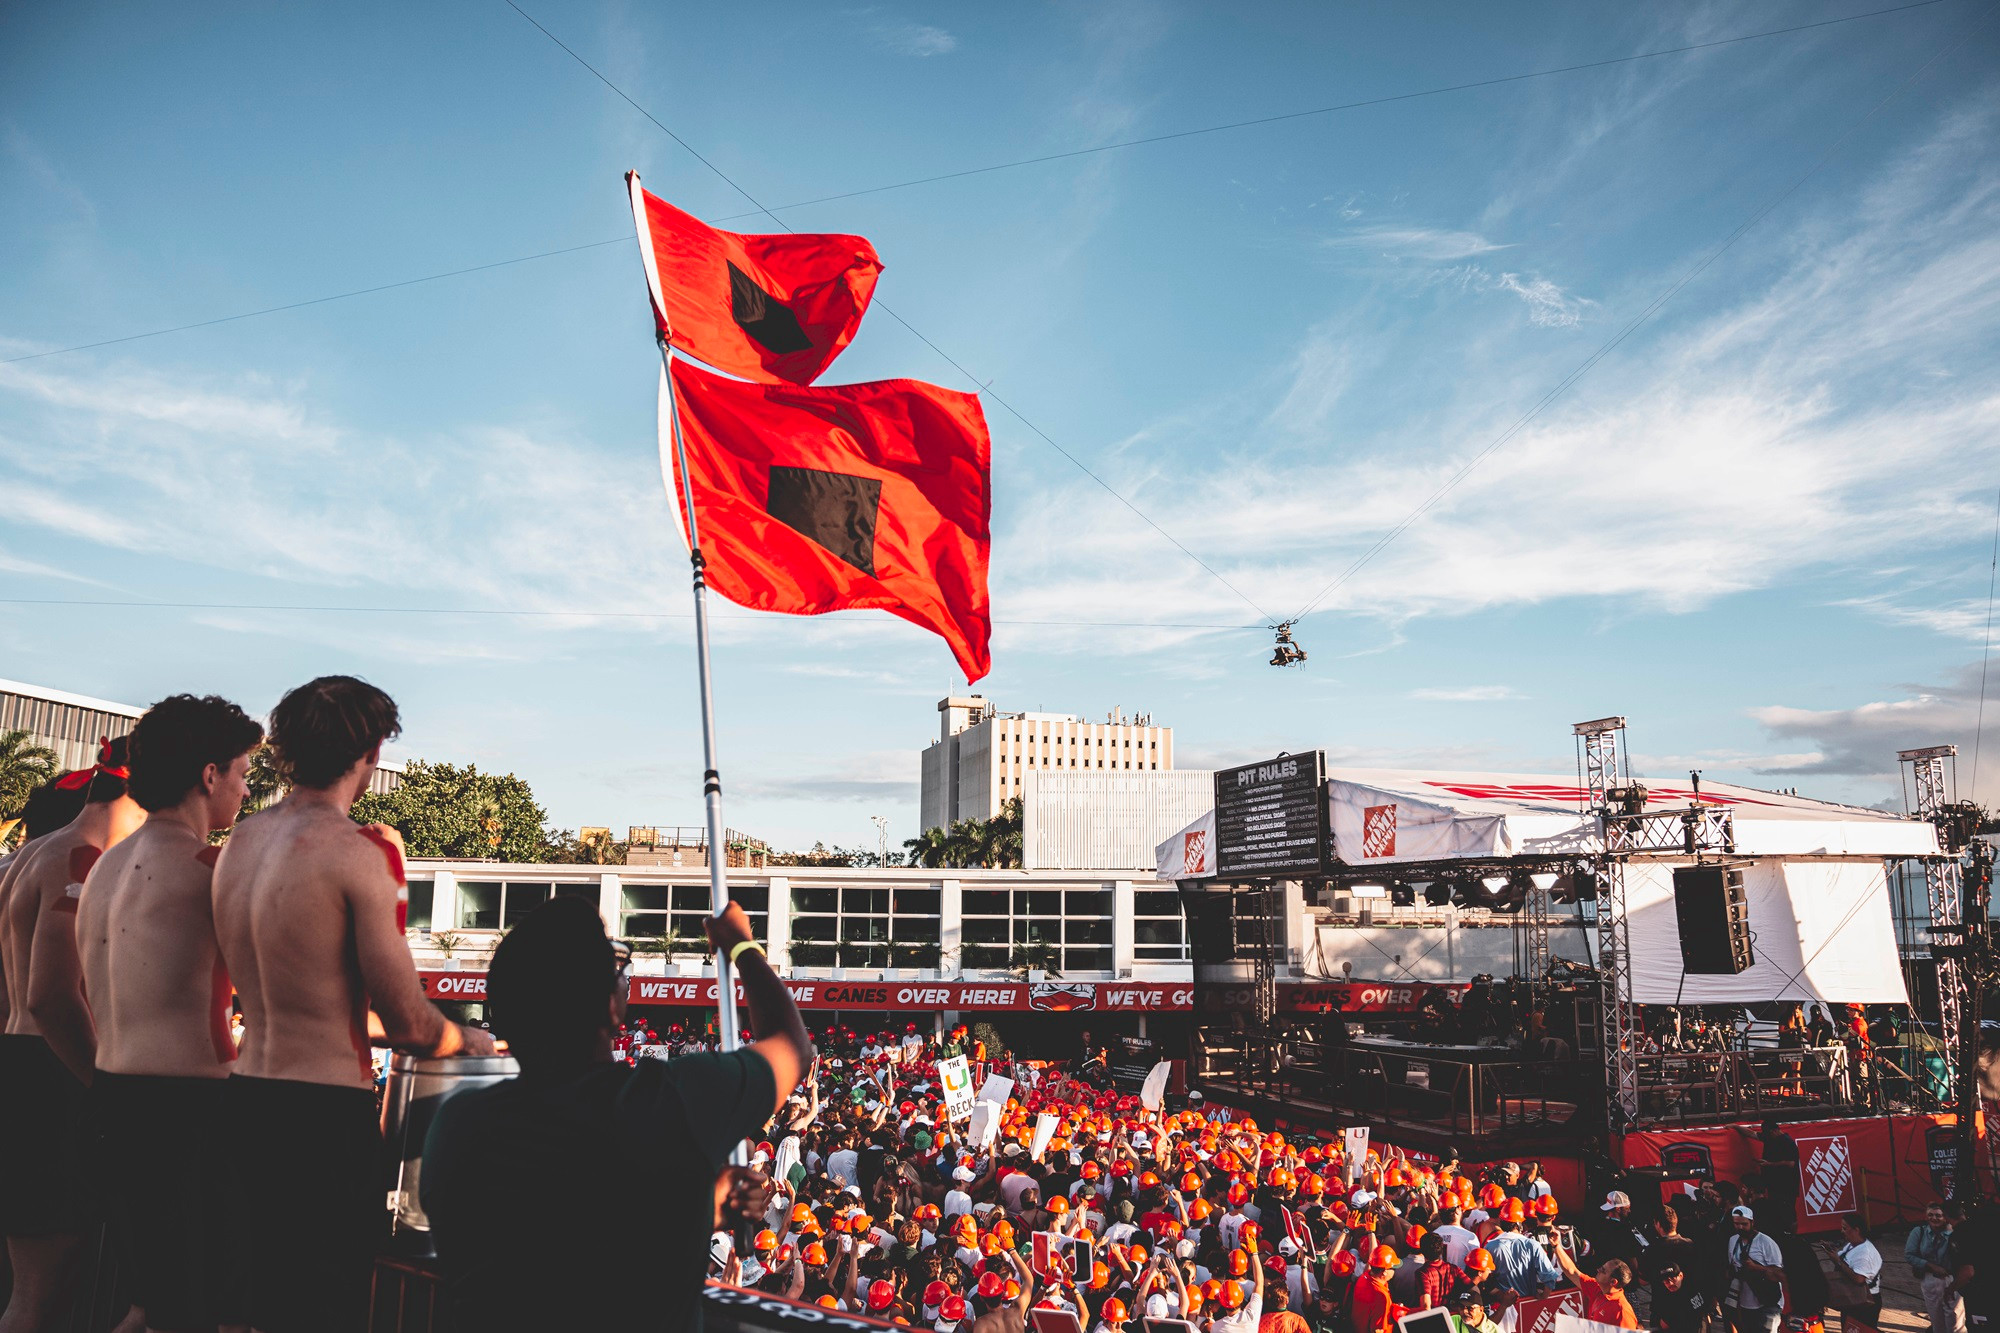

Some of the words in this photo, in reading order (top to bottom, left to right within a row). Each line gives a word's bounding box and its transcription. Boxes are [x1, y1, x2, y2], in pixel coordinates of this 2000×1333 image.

[1238, 768, 1256, 786] PIT
[1259, 760, 1298, 782] RULES
[1252, 812, 1272, 821] POLITICAL
[1367, 811, 1380, 832] THE
[1363, 805, 1396, 857] HOME
[1376, 823, 1396, 857] DEPOT
[1184, 831, 1204, 873] HOME
[437, 978, 488, 993] OVER
[640, 983, 698, 998] WE'VE
[706, 984, 745, 1000] GT
[787, 986, 815, 1002] ME
[824, 987, 888, 1003] CANES
[897, 988, 950, 1004] OVER
[959, 989, 1017, 1005] HERE!
[1105, 990, 1163, 1006] WE'VE
[1289, 989, 1352, 1005] CANES
[1360, 989, 1413, 1004] OVER
[1132, 1038, 1152, 1047] RULES
[947, 1060, 960, 1070] THE
[945, 1068, 968, 1091] U
[956, 1091, 963, 1099] IS
[950, 1097, 975, 1117] BECK
[1353, 1128, 1365, 1138] U
[1805, 1146, 1824, 1177] THE
[1805, 1137, 1848, 1214] HOME
[1825, 1163, 1851, 1212] DEPOT
